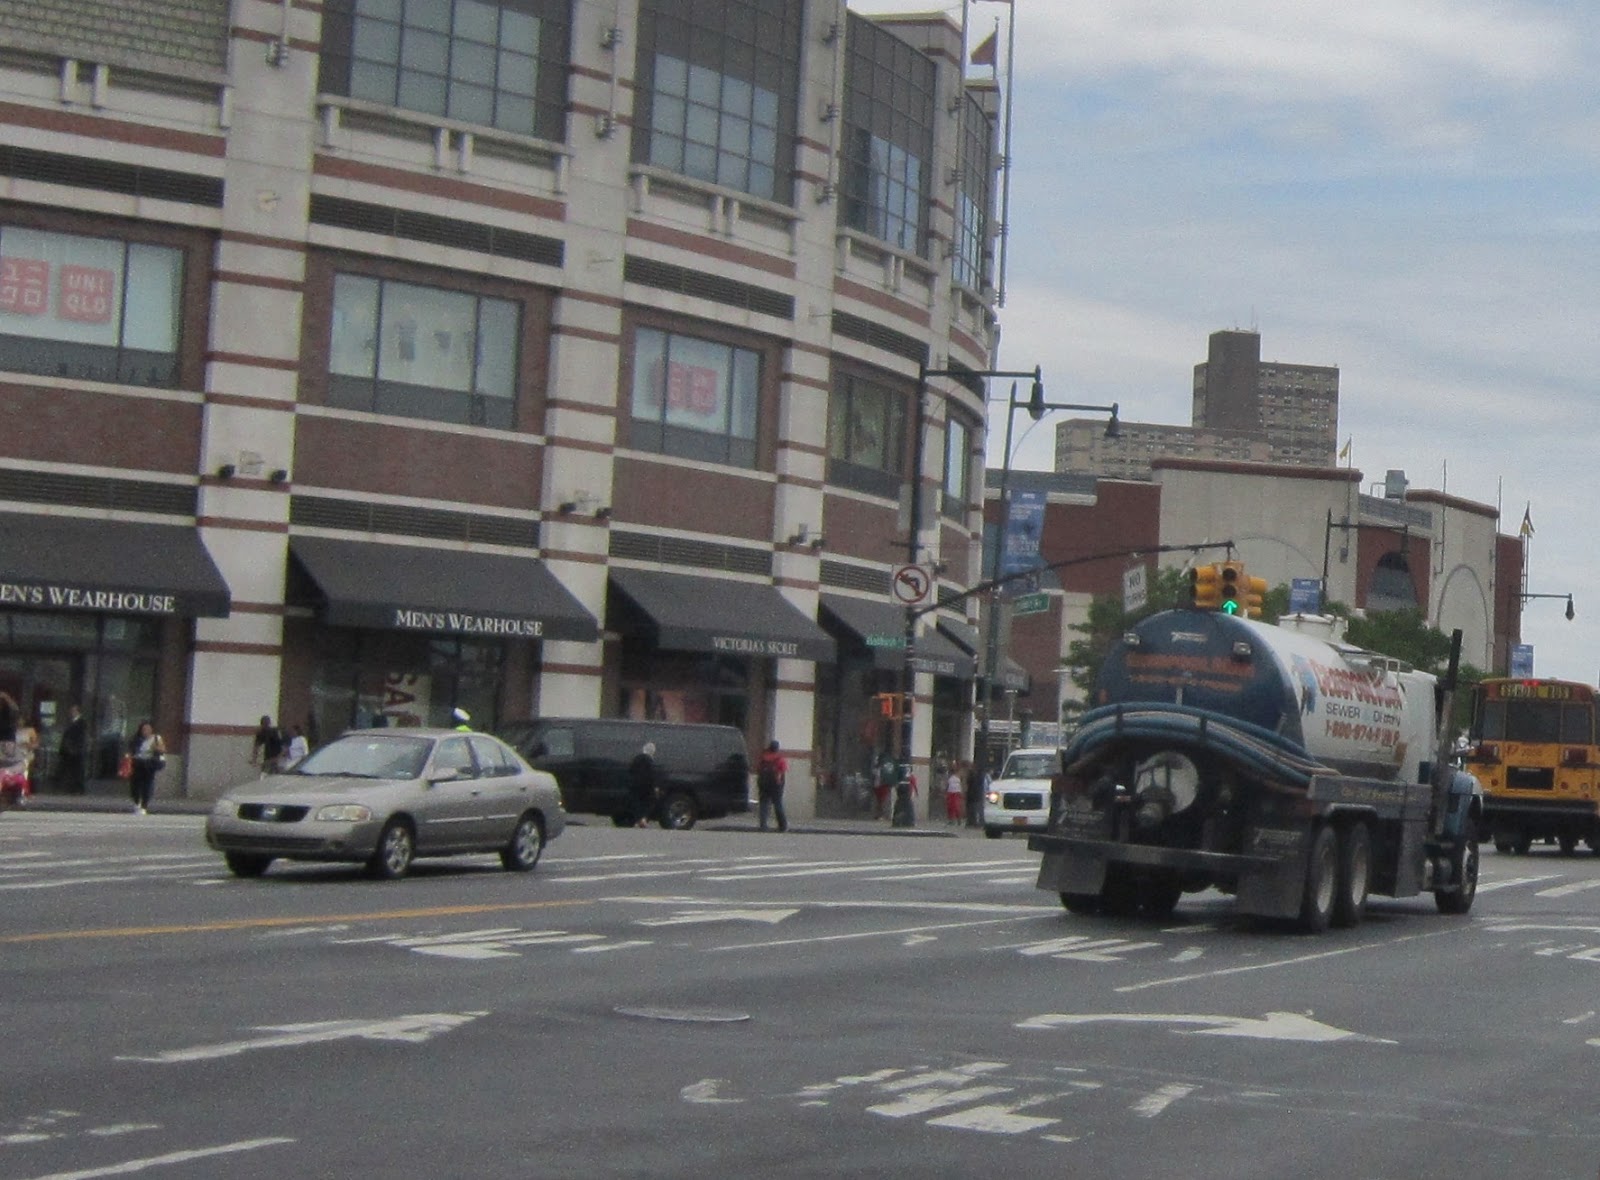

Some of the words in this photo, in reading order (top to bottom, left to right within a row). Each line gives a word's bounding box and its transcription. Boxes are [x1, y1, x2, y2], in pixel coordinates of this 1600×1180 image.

[69, 273, 106, 294] UNI
[66, 293, 107, 314] QLO
[0, 584, 43, 604] EN'S
[48, 586, 176, 613] WEARHOUSE
[396, 609, 445, 630] MEN'S
[448, 612, 544, 637] WEARHOUSE
[1325, 702, 1361, 719] SEWER
